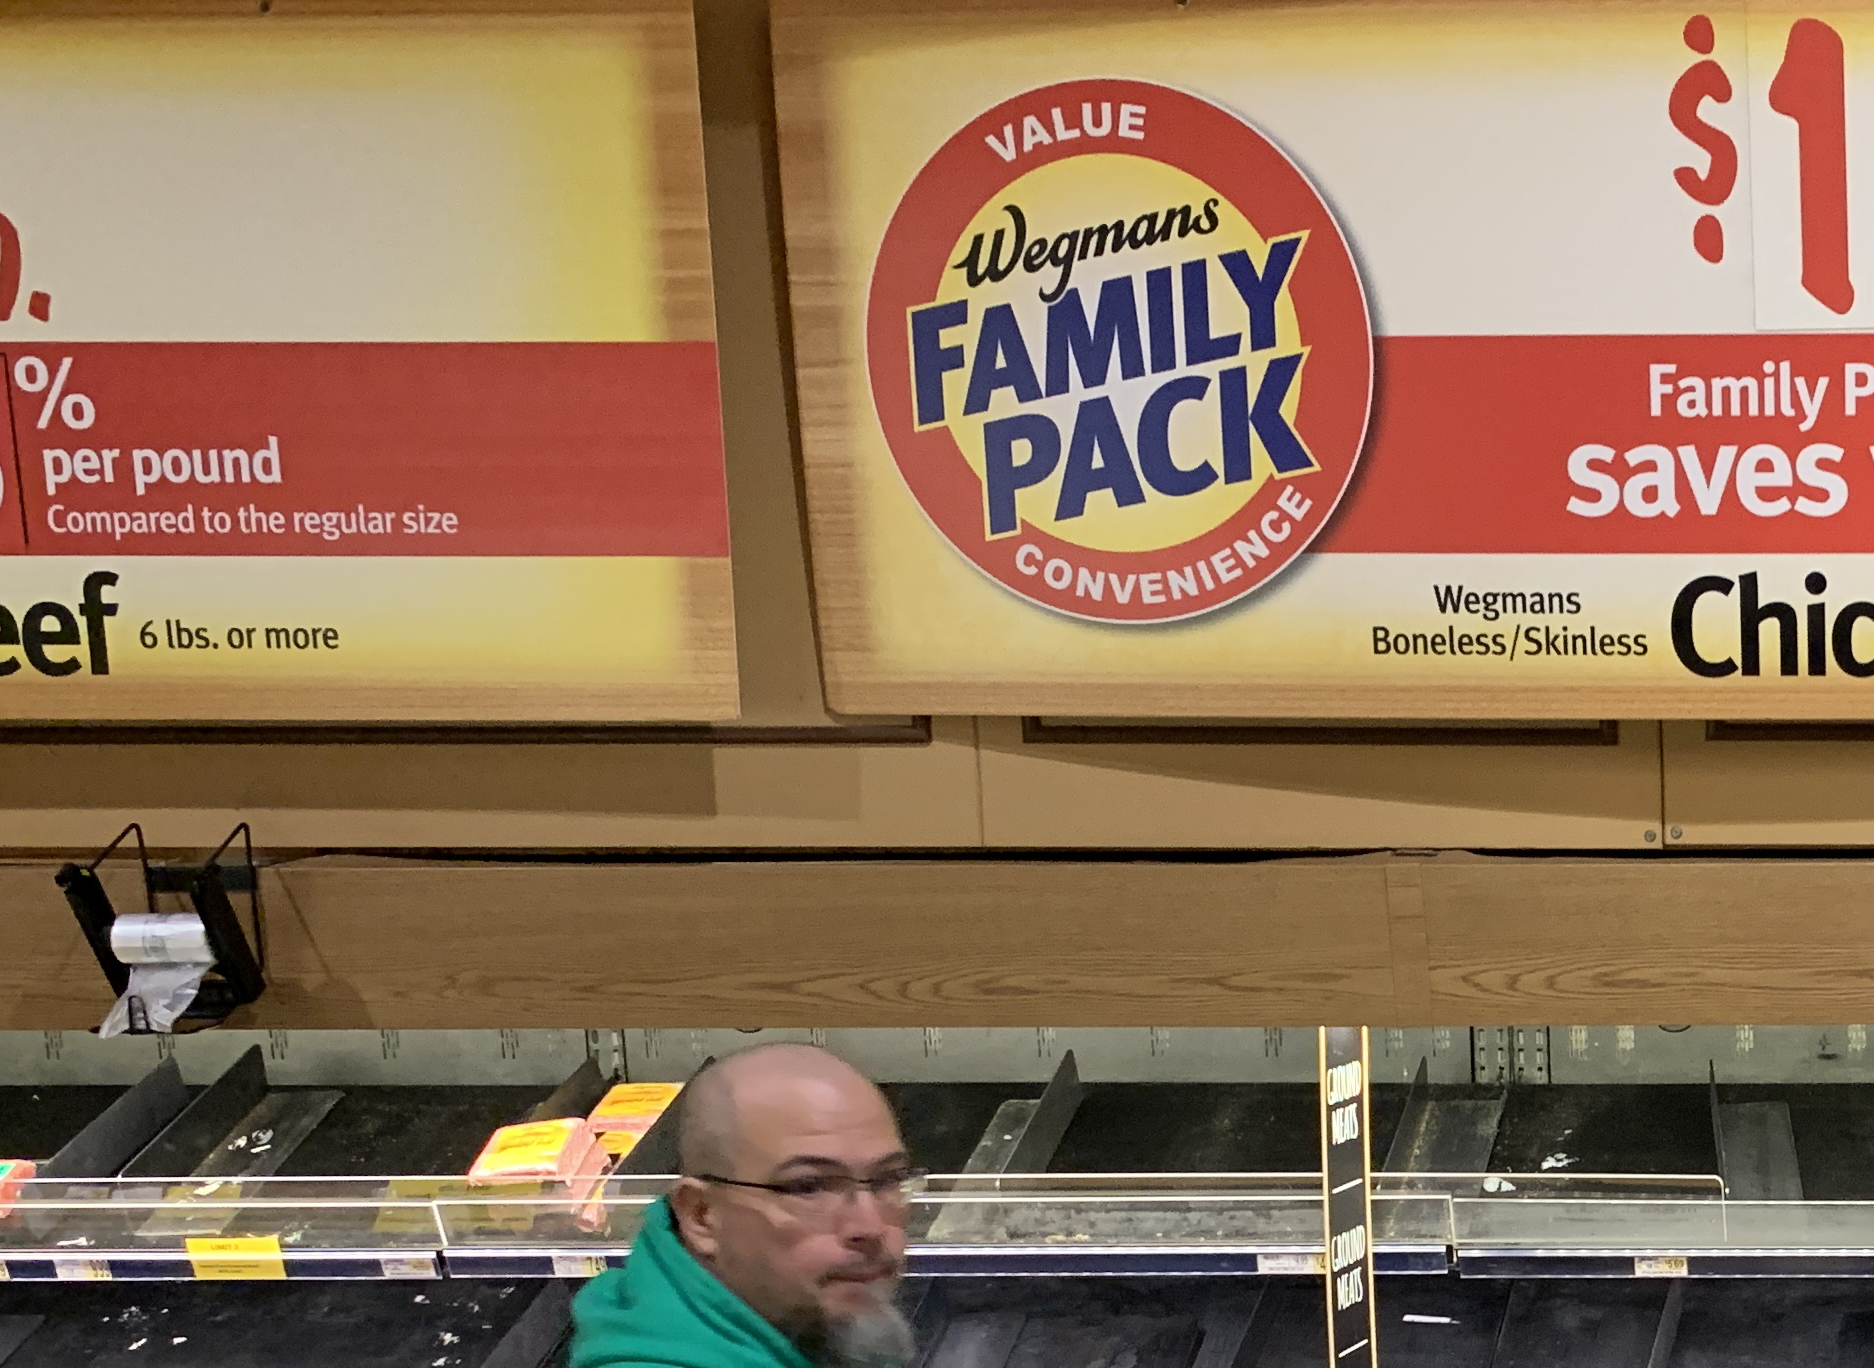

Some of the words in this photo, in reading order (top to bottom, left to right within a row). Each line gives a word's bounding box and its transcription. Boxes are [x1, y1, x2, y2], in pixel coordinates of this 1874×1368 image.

[985, 101, 1148, 163] VALUE
[952, 197, 1220, 303] Wegmans
[911, 238, 1303, 426] FAMILY
[1648, 360, 1830, 432] Family
[42, 447, 120, 497] per
[132, 434, 282, 497] pound
[982, 354, 1316, 538] PACK
[1566, 442, 1850, 519] saves
[46, 503, 195, 541] Compared
[202, 509, 231, 534] to
[237, 503, 286, 534] the
[293, 503, 396, 541] regular
[401, 504, 459, 534] size
[1013, 483, 1313, 606] CONVENIENCE
[1433, 585, 1582, 620] Wegmans
[139, 619, 159, 650] 6
[165, 618, 220, 650] lbs.
[226, 626, 257, 650] or
[264, 626, 340, 650] more
[1371, 623, 1649, 662] Boneless/Skinless
[1326, 1060, 1362, 1106] GROUND
[1331, 1102, 1359, 1146] MEATS
[1331, 1224, 1366, 1273] GROUND
[1336, 1266, 1364, 1312] MEATS
